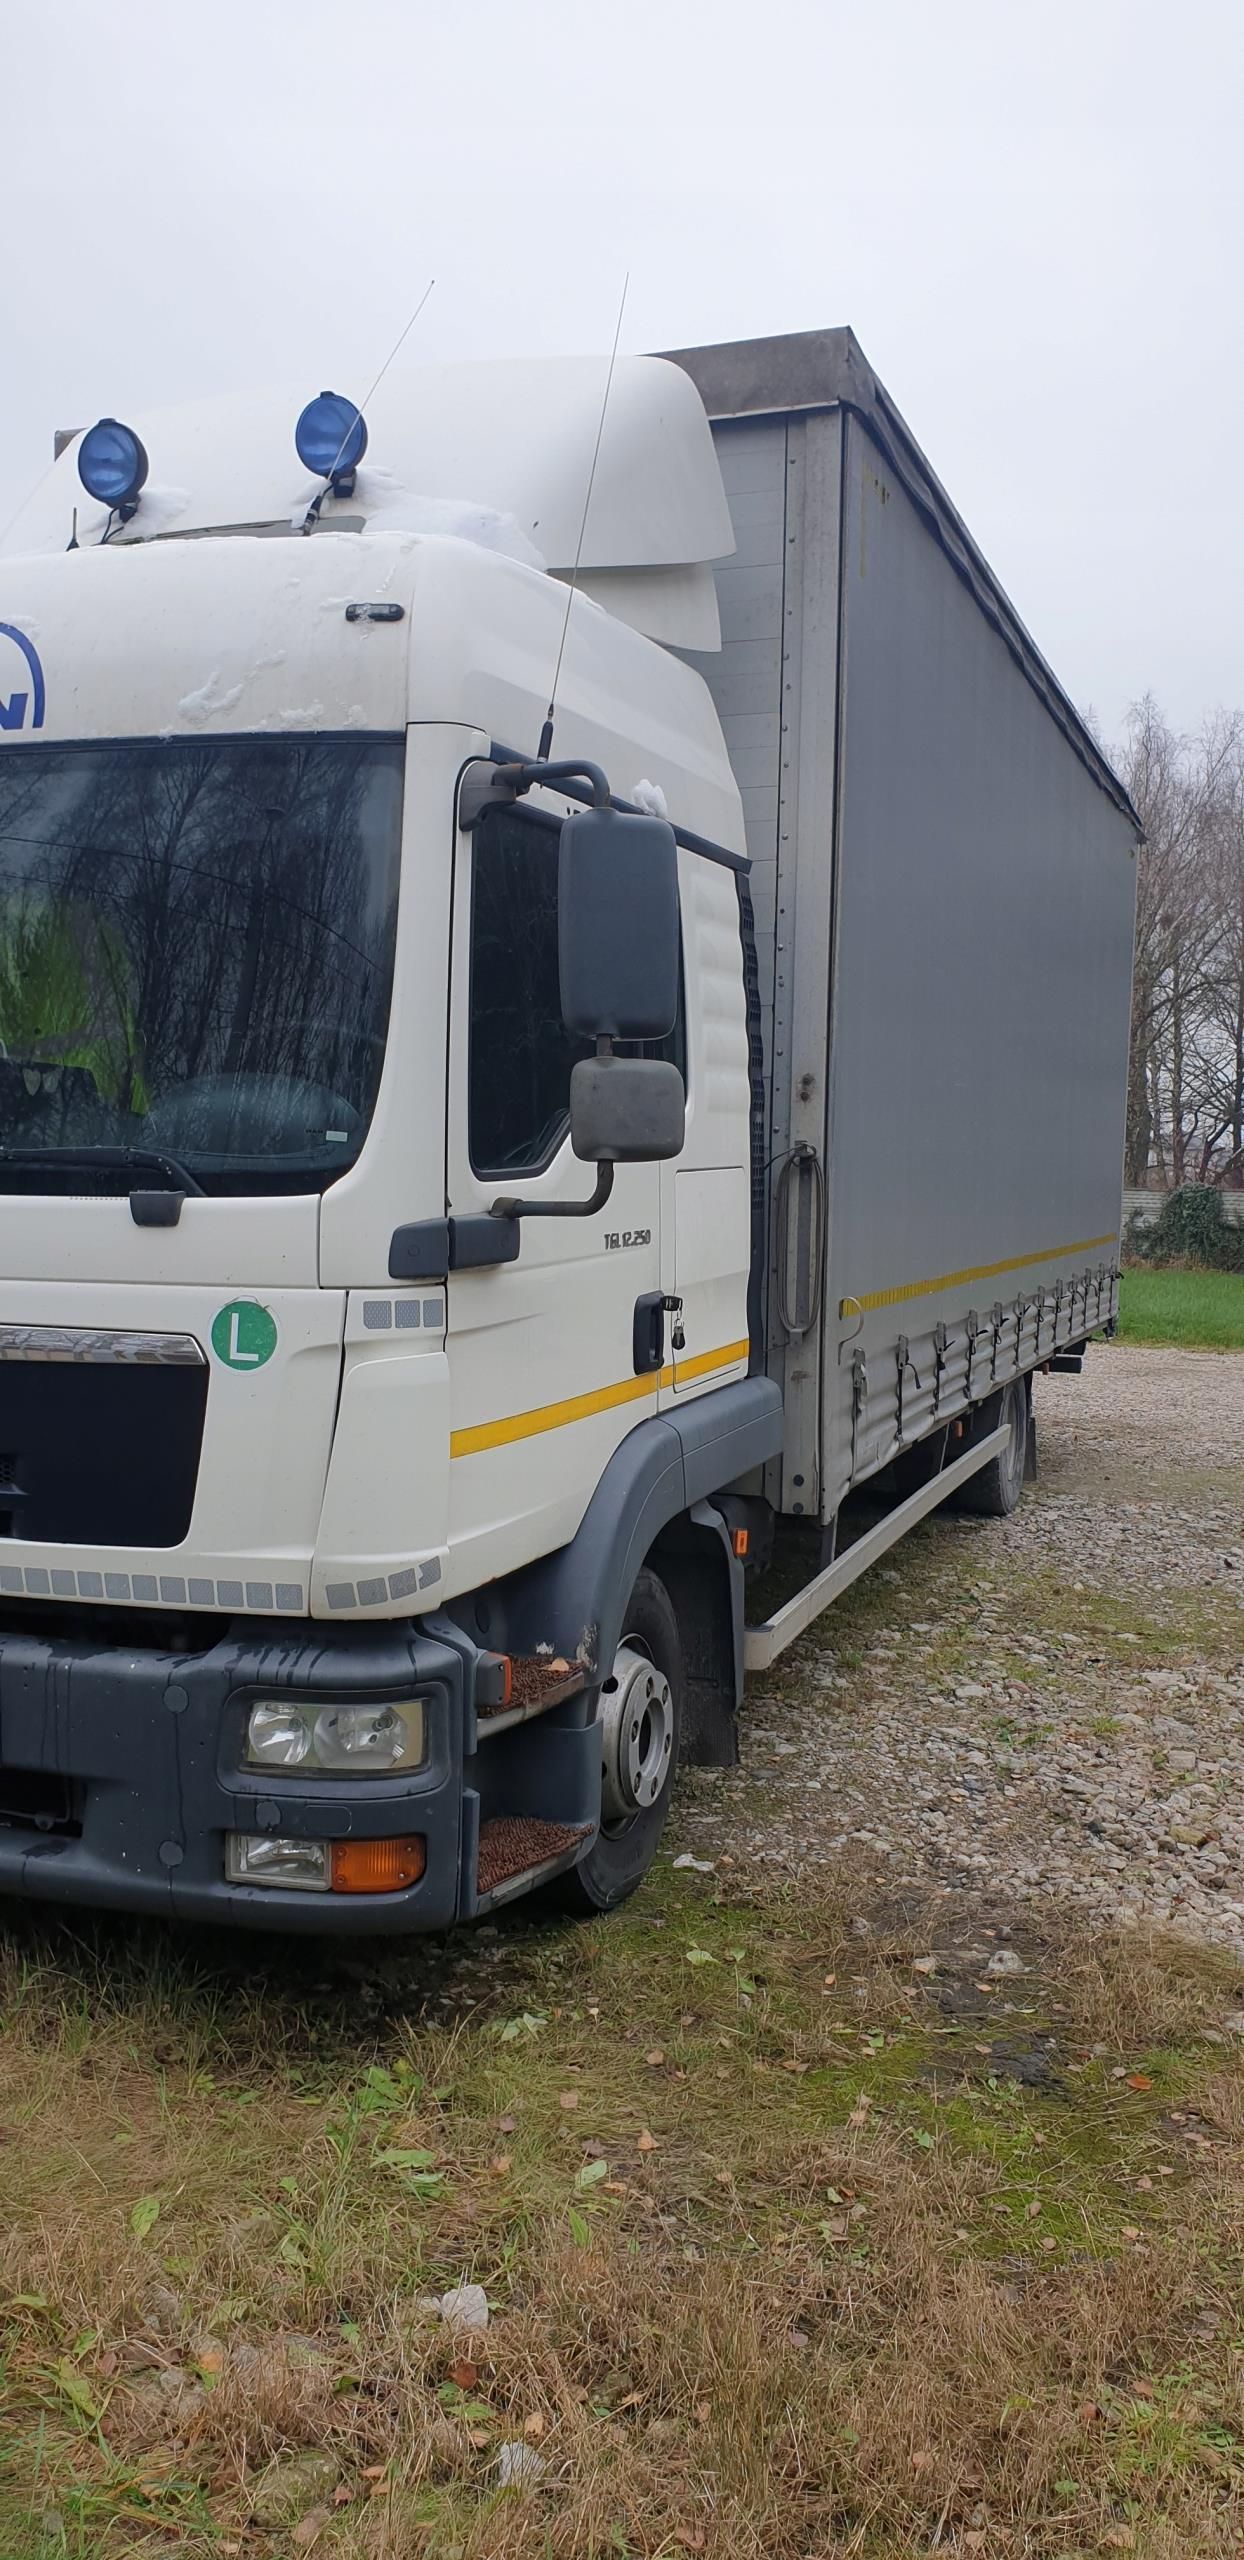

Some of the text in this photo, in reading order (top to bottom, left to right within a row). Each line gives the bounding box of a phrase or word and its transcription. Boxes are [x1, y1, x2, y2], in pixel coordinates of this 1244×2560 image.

[604, 1229, 651, 1250] TGL 12.250
[229, 1312, 259, 1362] L
